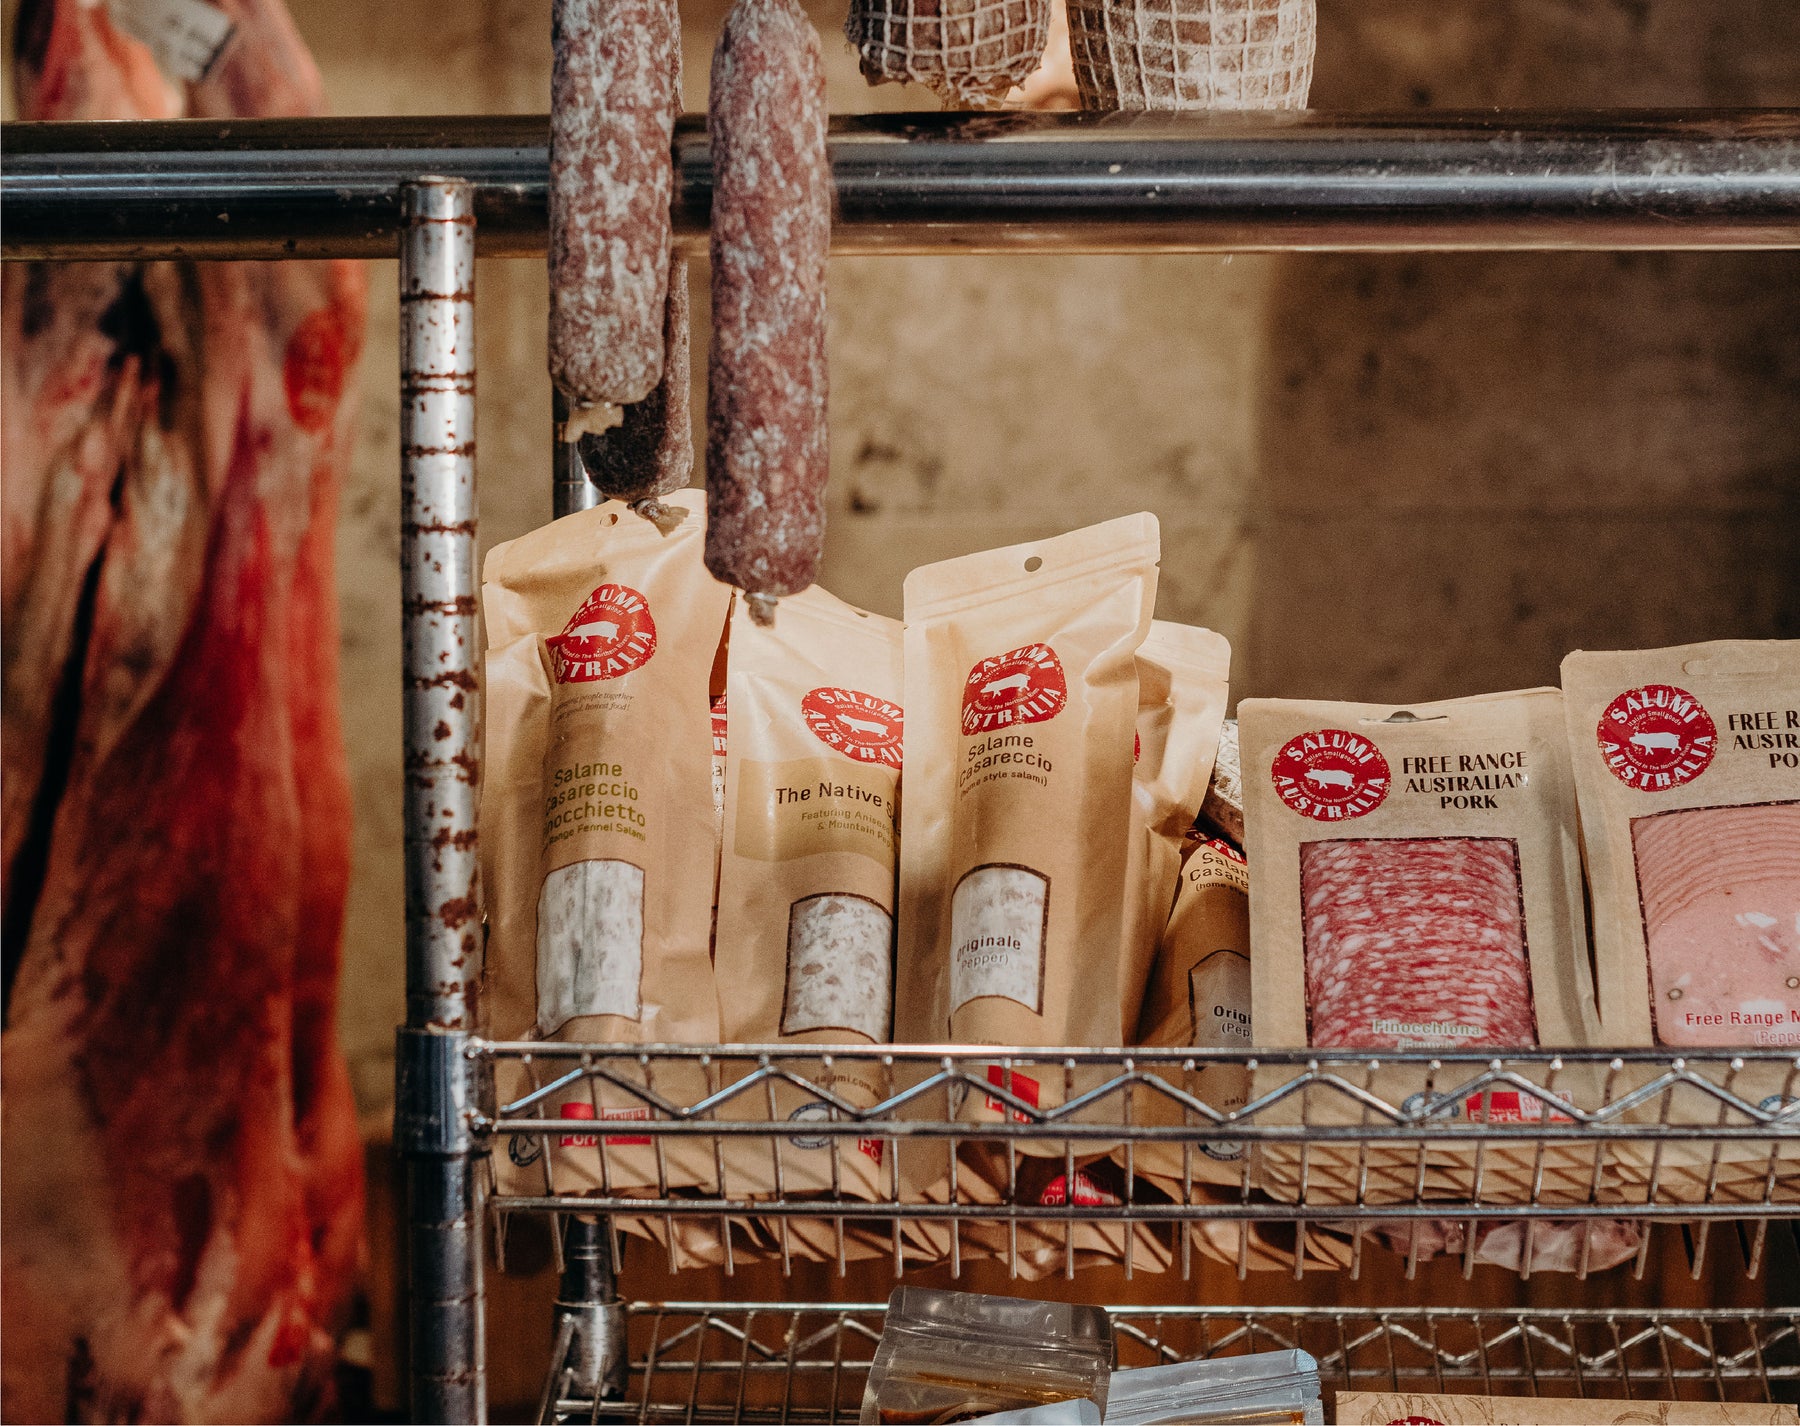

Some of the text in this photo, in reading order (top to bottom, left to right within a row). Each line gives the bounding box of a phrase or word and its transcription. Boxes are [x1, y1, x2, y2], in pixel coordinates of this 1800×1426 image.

[968, 646, 1056, 684] SALUMI
[962, 687, 1062, 730] AUSTRALIA
[1610, 689, 1700, 724] SALUMI
[1728, 711, 1780, 731] FREE
[968, 735, 1034, 762] Salame
[1286, 733, 1375, 764] SALUMI
[1733, 733, 1800, 751] AUSTR
[959, 751, 1053, 788] Casareccio
[1403, 751, 1529, 774] FREE RANGE
[1602, 735, 1713, 787] AUSTRALIA
[553, 762, 623, 788] Salame
[983, 771, 1008, 783] style
[1010, 771, 1048, 787] salami)
[1405, 772, 1529, 794] AUSTRALIAN
[775, 787, 811, 804] The
[818, 782, 883, 807] Native
[1277, 775, 1386, 818] AUSTRALIA
[1440, 794, 1499, 810] PORK
[801, 808, 851, 822] Featuring
[577, 822, 613, 839] Fennel
[616, 823, 647, 842] Salami
[817, 822, 826, 831] &
[828, 820, 875, 836] Mountain
[1373, 1020, 1482, 1036] Finocchiona
[1685, 1013, 1724, 1026] Free
[1730, 1011, 1784, 1027] Range
[1221, 1022, 1251, 1039] (Pep
